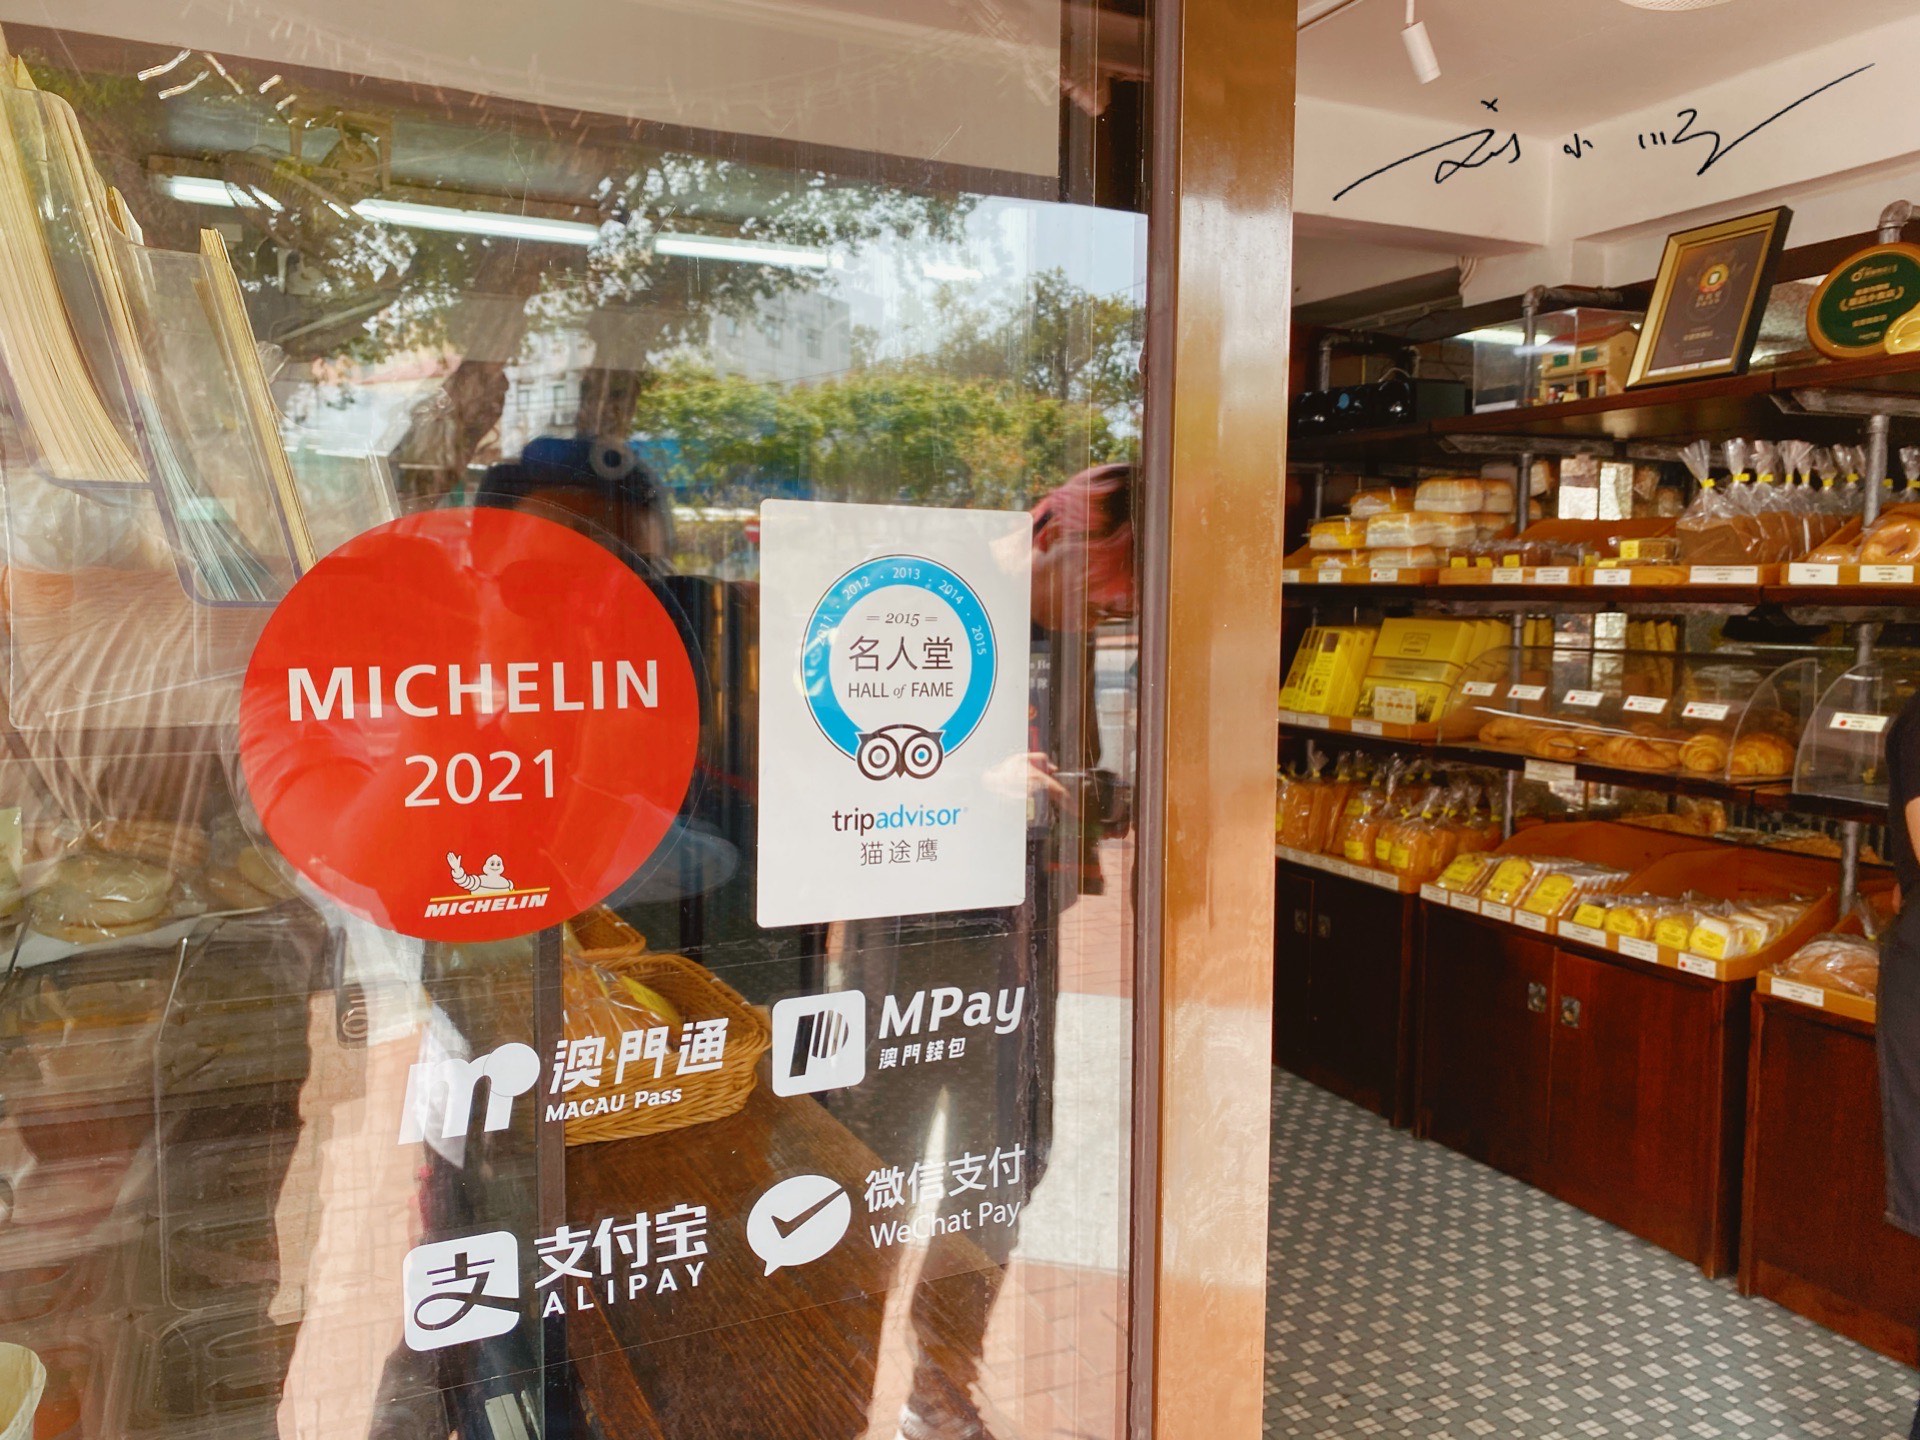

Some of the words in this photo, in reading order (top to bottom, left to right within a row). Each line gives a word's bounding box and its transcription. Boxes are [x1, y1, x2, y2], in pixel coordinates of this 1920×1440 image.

[842, 576, 871, 600] 2012
[893, 567, 920, 580] 2013
[938, 579, 964, 604] 2014
[971, 625, 987, 655] 2015
[885, 613, 920, 627] 2015
[848, 635, 953, 672] 名人堂
[288, 660, 658, 721] MICHELIN
[848, 682, 889, 698] HALL
[893, 684, 907, 699] of
[911, 681, 953, 697] FAME
[404, 749, 554, 807] 2021
[832, 804, 961, 836] tripadvisor
[860, 838, 938, 866] 猫途鹰
[424, 894, 548, 918] MICHELIN
[878, 986, 1025, 1039] MPay
[550, 1018, 729, 1094] 澳門通
[878, 1038, 966, 1069] 澳門錢包
[545, 1093, 626, 1122] MACAU
[634, 1088, 682, 1109] Pass
[864, 1143, 1026, 1213] 微信支付
[534, 1203, 708, 1289] 支付宝
[869, 1208, 972, 1249] WeChat
[979, 1201, 1021, 1228] Pay
[542, 1261, 704, 1318] ALIPAY
